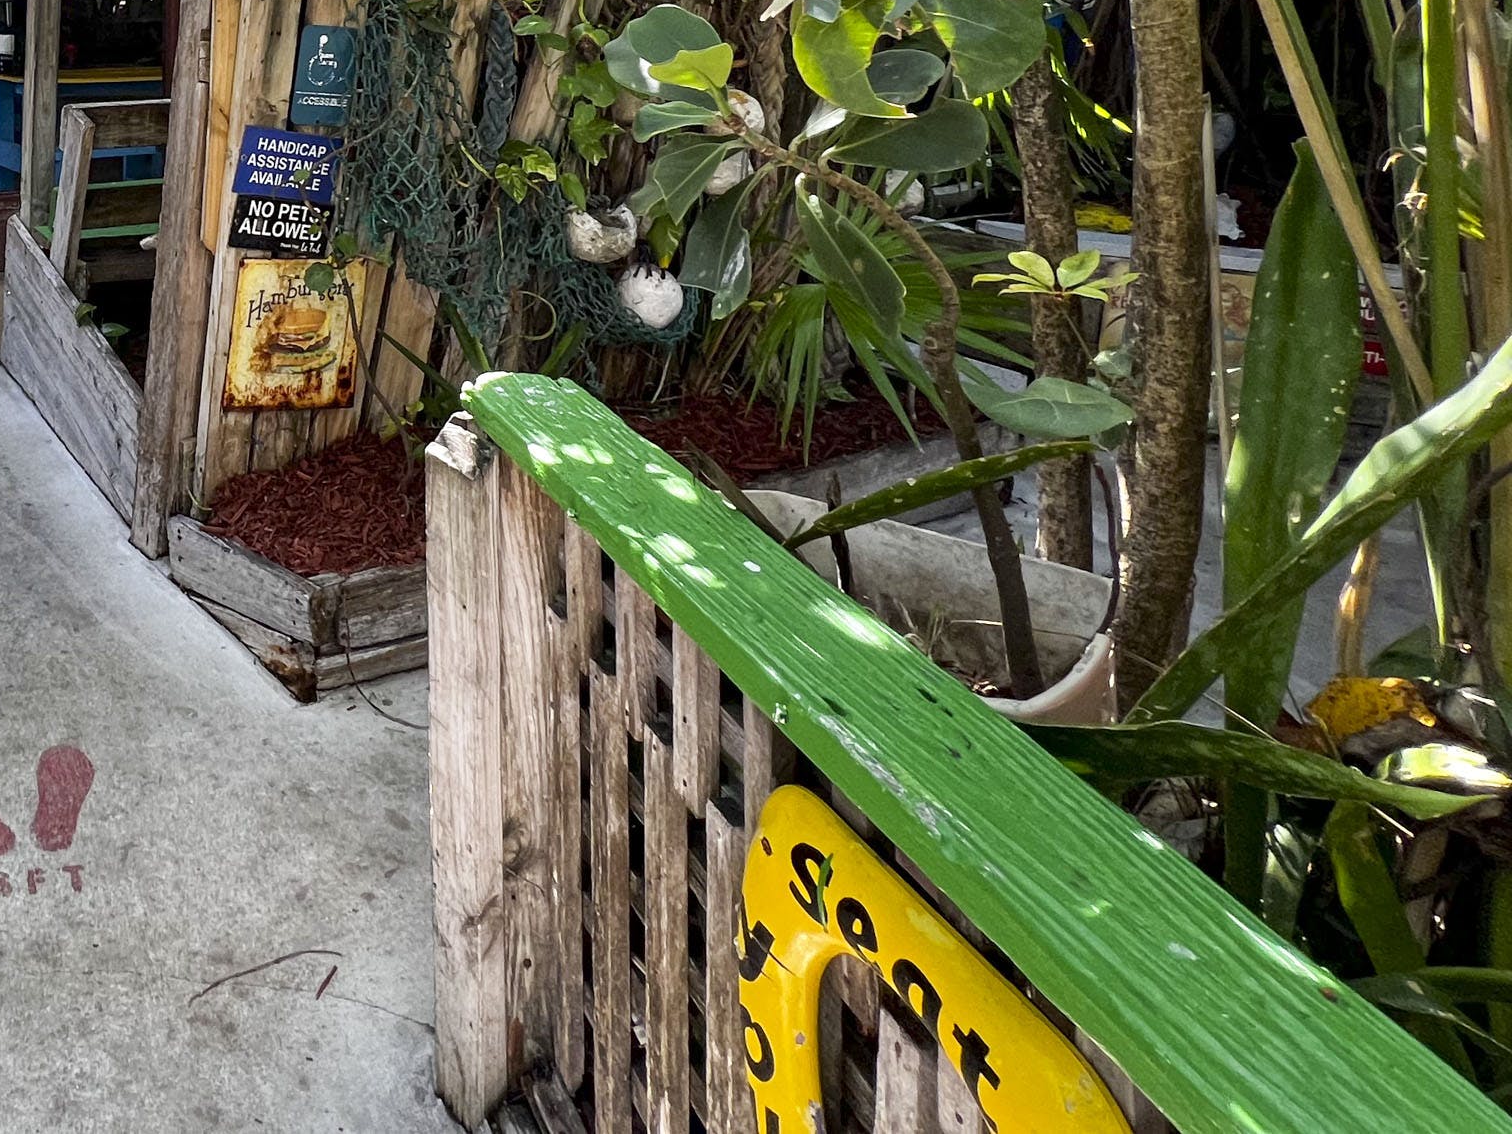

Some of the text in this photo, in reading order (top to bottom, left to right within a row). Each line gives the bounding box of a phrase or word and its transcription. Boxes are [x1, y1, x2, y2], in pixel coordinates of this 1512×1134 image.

[257, 137, 327, 159] HANDICAP
[248, 199, 322, 224] NO PETS
[238, 218, 322, 242] ALLOWED
[789, 842, 1002, 1134] Seat
